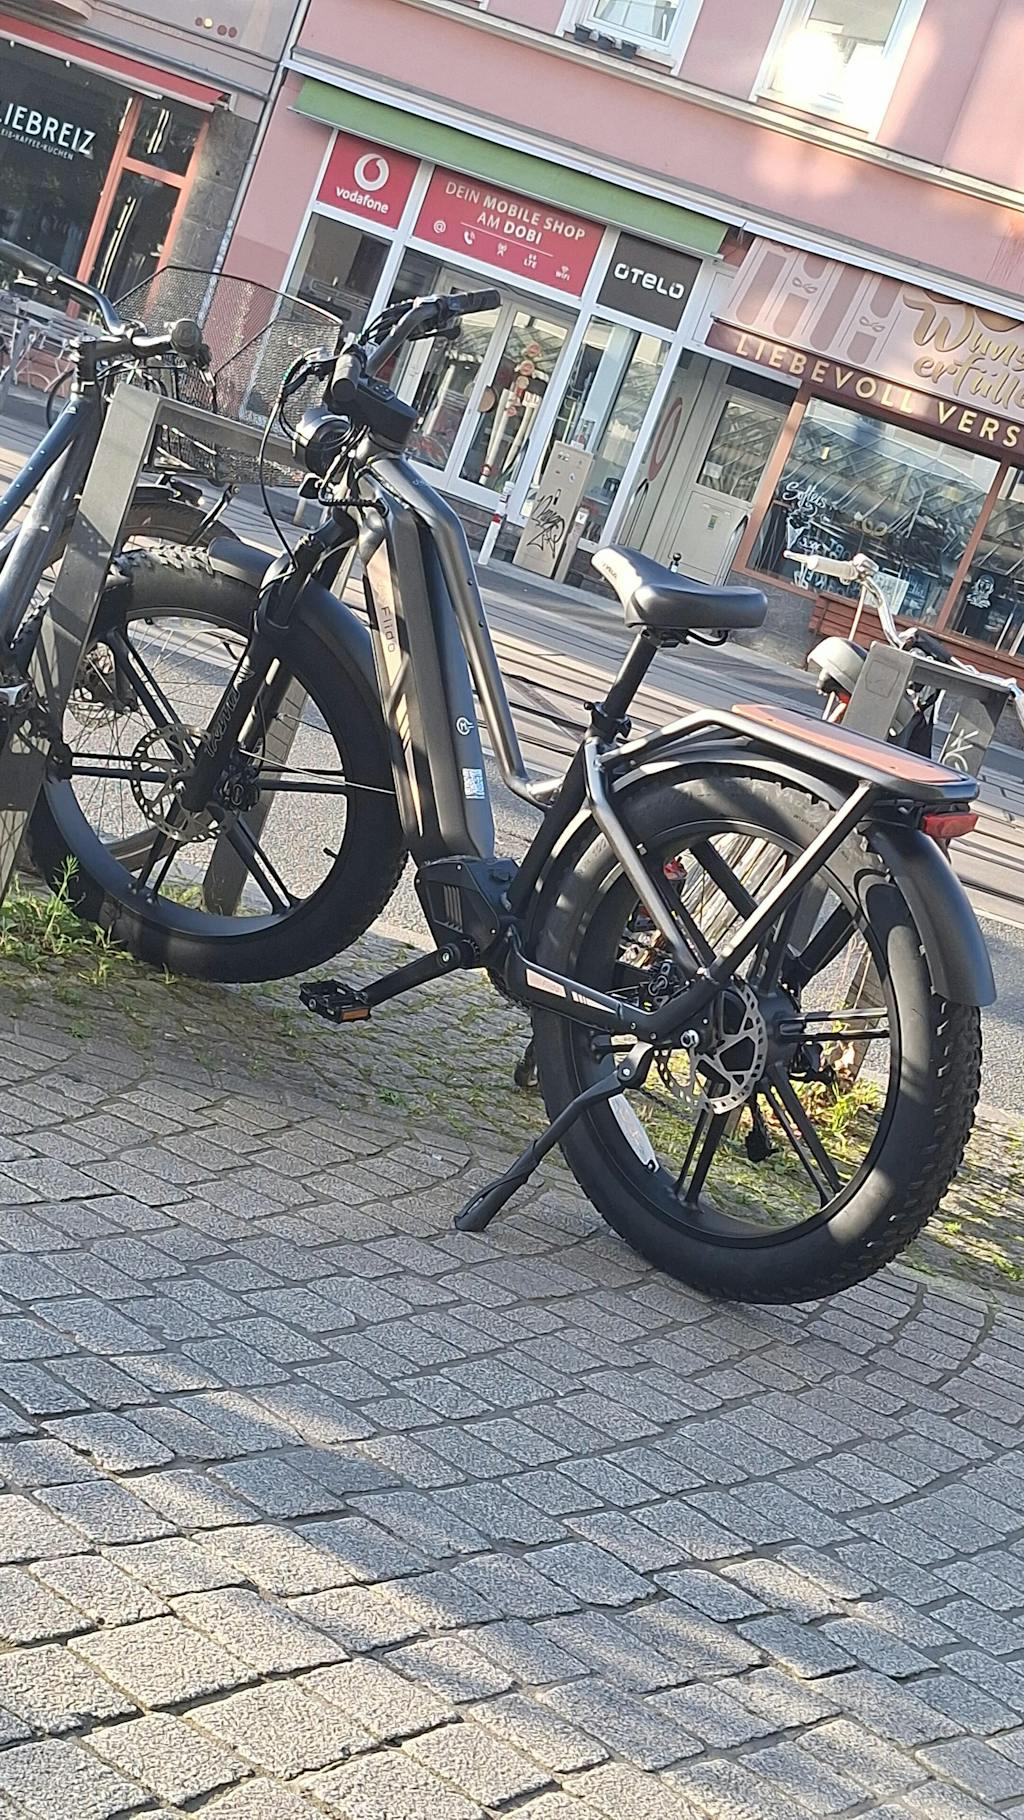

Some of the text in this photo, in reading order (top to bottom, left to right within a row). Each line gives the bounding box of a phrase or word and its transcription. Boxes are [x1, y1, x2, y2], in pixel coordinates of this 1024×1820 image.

[0, 103, 96, 155] IEBREIZ
[336, 186, 389, 214] vodafone
[446, 181, 586, 241] DEIN MOBILE SHOP
[477, 212, 542, 245] AM DOBI
[735, 334, 1022, 449] LIEBEVOLL VERS
